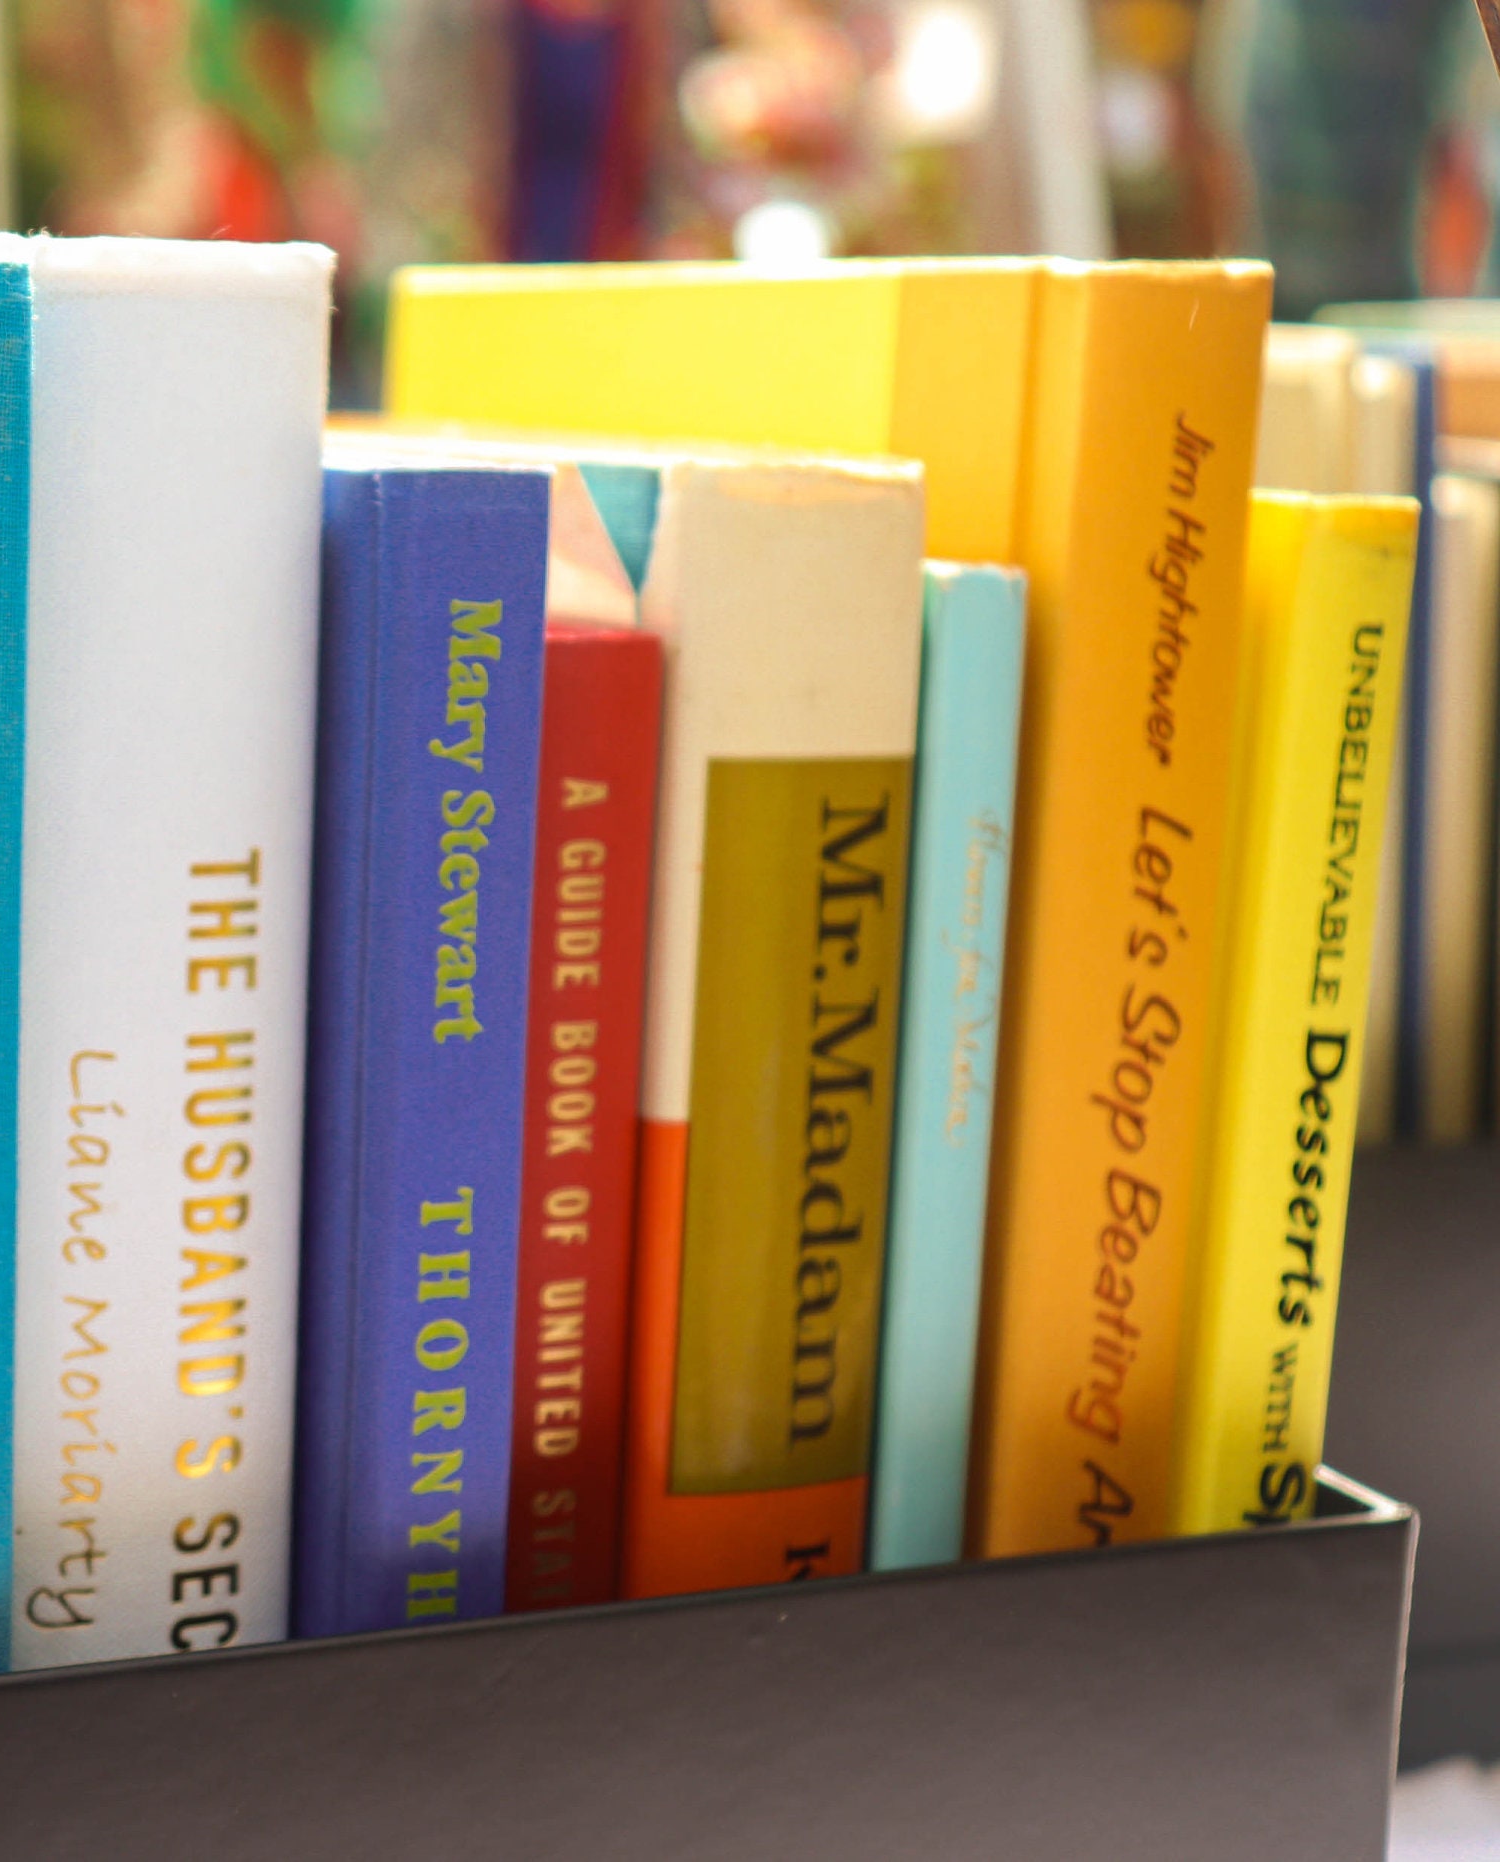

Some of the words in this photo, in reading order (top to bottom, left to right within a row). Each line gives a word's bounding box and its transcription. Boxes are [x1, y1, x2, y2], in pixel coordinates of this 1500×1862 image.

[1166, 409, 1216, 500] Jim
[428, 598, 504, 774] Mary
[1146, 506, 1207, 770] Hightower
[560, 776, 611, 810] A
[1305, 622, 1386, 1008] UNBELIEVABLE
[184, 845, 261, 995] THE
[432, 789, 496, 1044] Stewart
[551, 838, 607, 991] GUIDE
[1127, 803, 1195, 968] Let's
[61, 1048, 126, 1265] Liane
[546, 1020, 600, 1157] BOOK
[1091, 982, 1183, 1156] Stop
[173, 1028, 257, 1480] HUSBAND'S
[541, 1186, 593, 1245] OF
[1276, 1026, 1351, 1329] Desserts
[531, 1278, 588, 1459] UNITED
[1066, 1166, 1163, 1446] Beating
[25, 1295, 118, 1630] Moriarty
[169, 1511, 241, 1651] SEC
